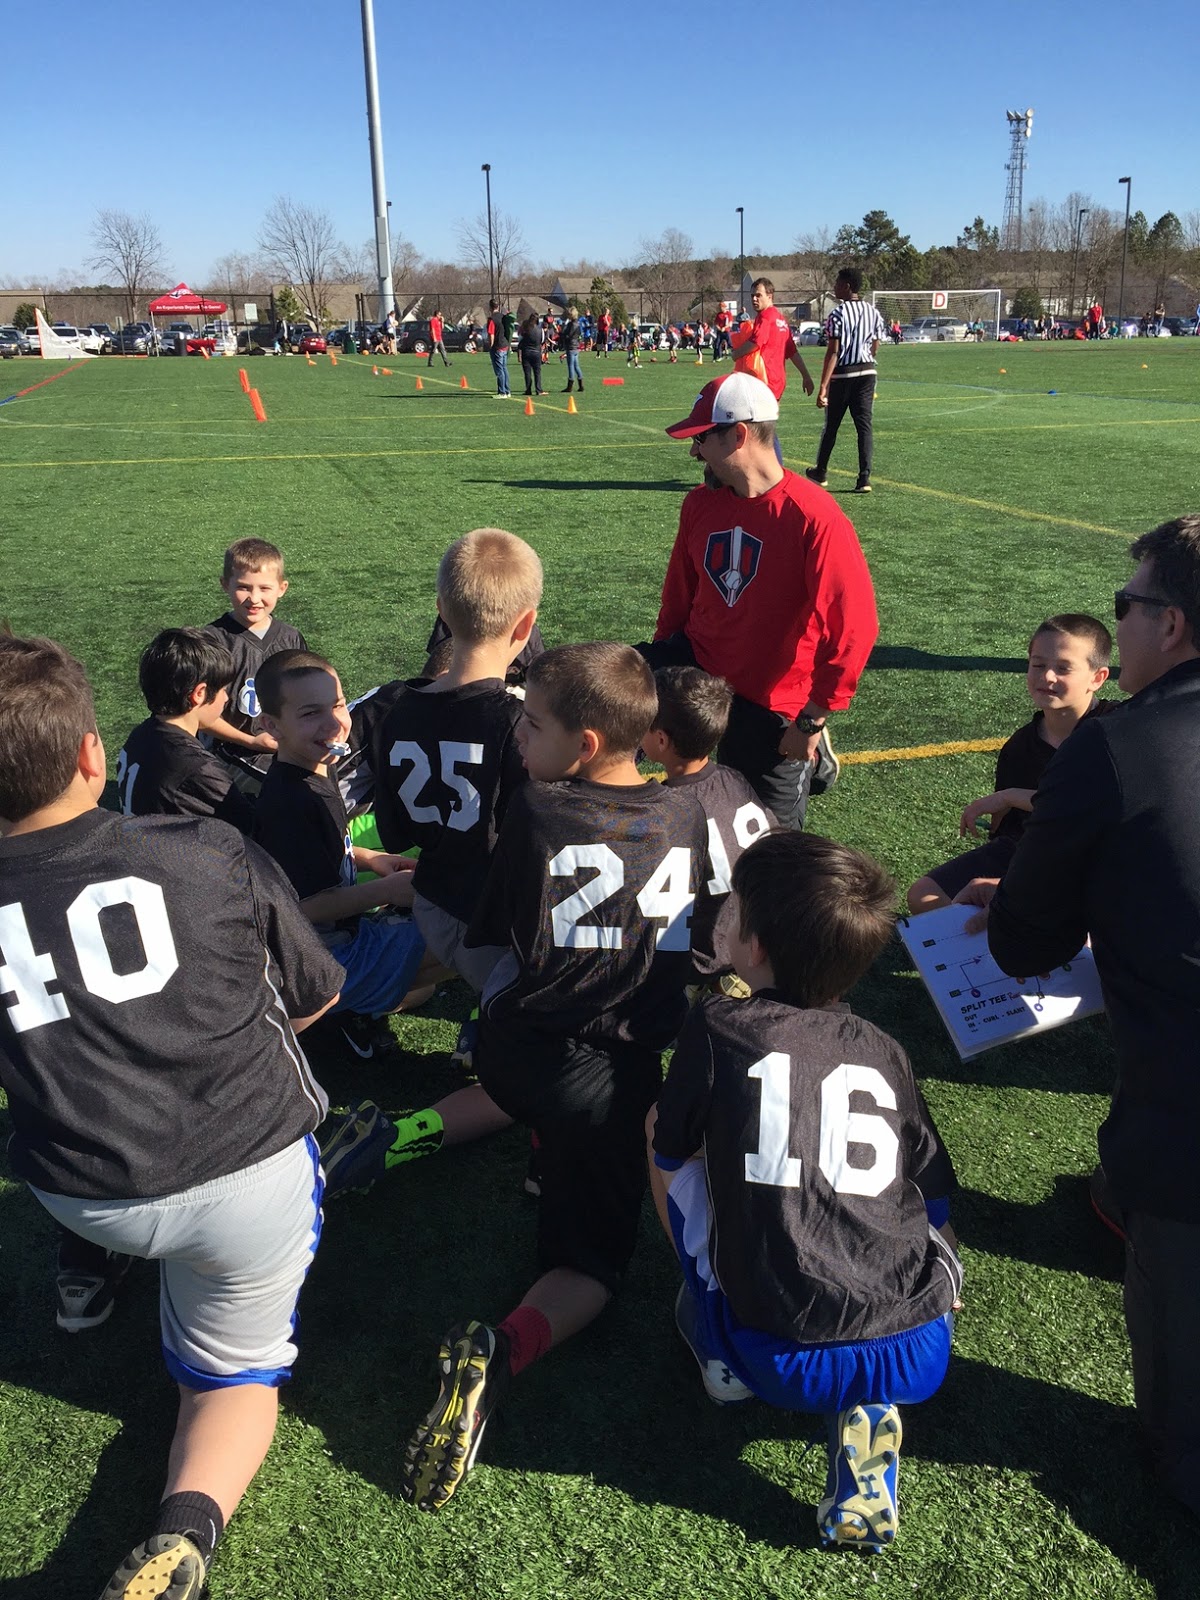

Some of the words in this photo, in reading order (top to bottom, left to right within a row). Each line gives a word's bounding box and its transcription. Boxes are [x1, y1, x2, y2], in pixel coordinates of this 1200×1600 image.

[934, 292, 946, 308] D
[389, 741, 484, 832] 25
[549, 843, 696, 952] 24
[0, 875, 179, 1034] 40
[961, 1000, 986, 1014] SPLIT
[988, 994, 1007, 1005] TEE
[1006, 1006, 1025, 1016] SLANT
[744, 1051, 900, 1198] 16
[65, 1287, 88, 1298] NIKE
